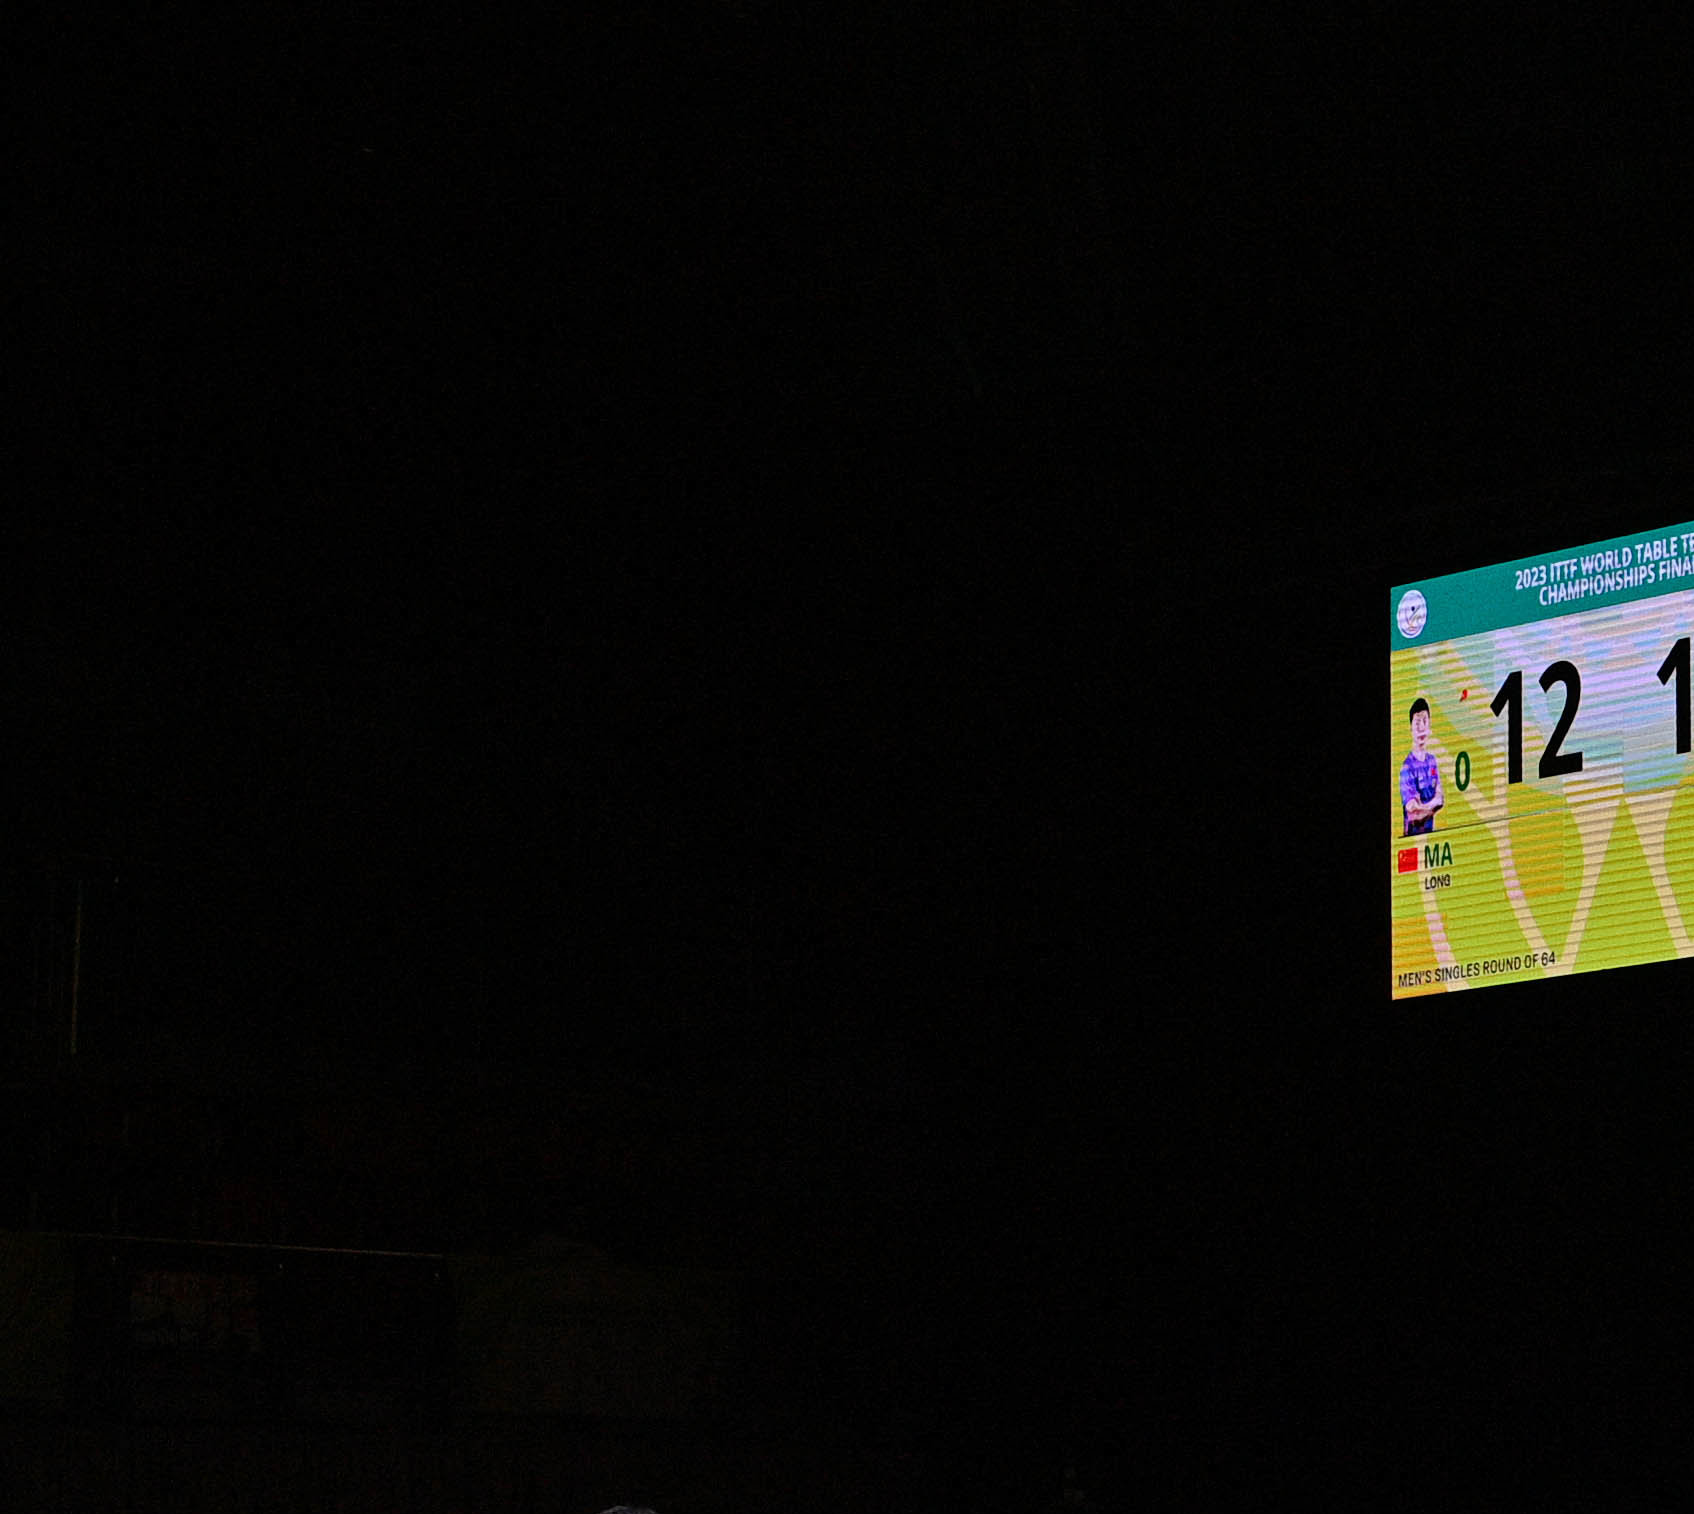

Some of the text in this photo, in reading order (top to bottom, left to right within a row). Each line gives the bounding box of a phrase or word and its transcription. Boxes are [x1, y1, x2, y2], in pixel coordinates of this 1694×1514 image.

[1515, 566, 1547, 590] 2023
[1549, 559, 1577, 584] ITTF
[1579, 547, 1631, 578] WORLD
[1635, 536, 1678, 568] TABLE
[1539, 566, 1655, 607] CHAMPIONSHIPS
[1490, 660, 1583, 785] 12
[1454, 751, 1471, 791] 0
[1424, 843, 1452, 869] MA
[1424, 873, 1451, 890] LONG
[1398, 951, 1556, 988] MEN'S SINGLES ROUND OF 64
